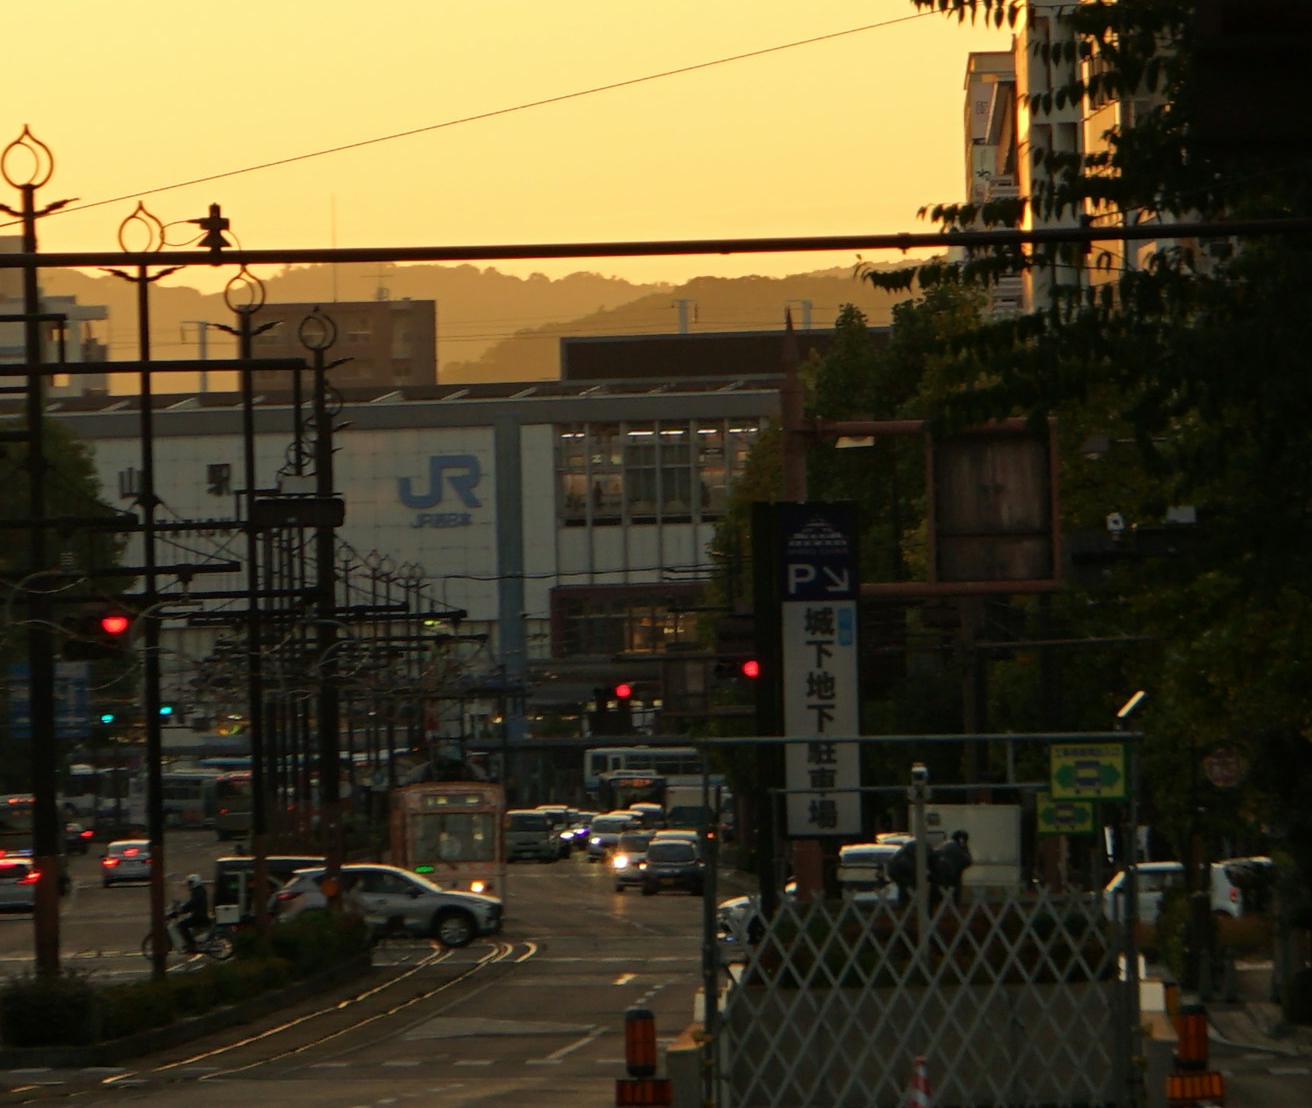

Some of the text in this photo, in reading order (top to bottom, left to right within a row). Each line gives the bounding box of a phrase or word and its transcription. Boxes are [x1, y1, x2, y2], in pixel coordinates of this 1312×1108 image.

[399, 455, 482, 509] JR
[788, 563, 816, 594] P
[804, 606, 839, 829] 城下地下駐車場
